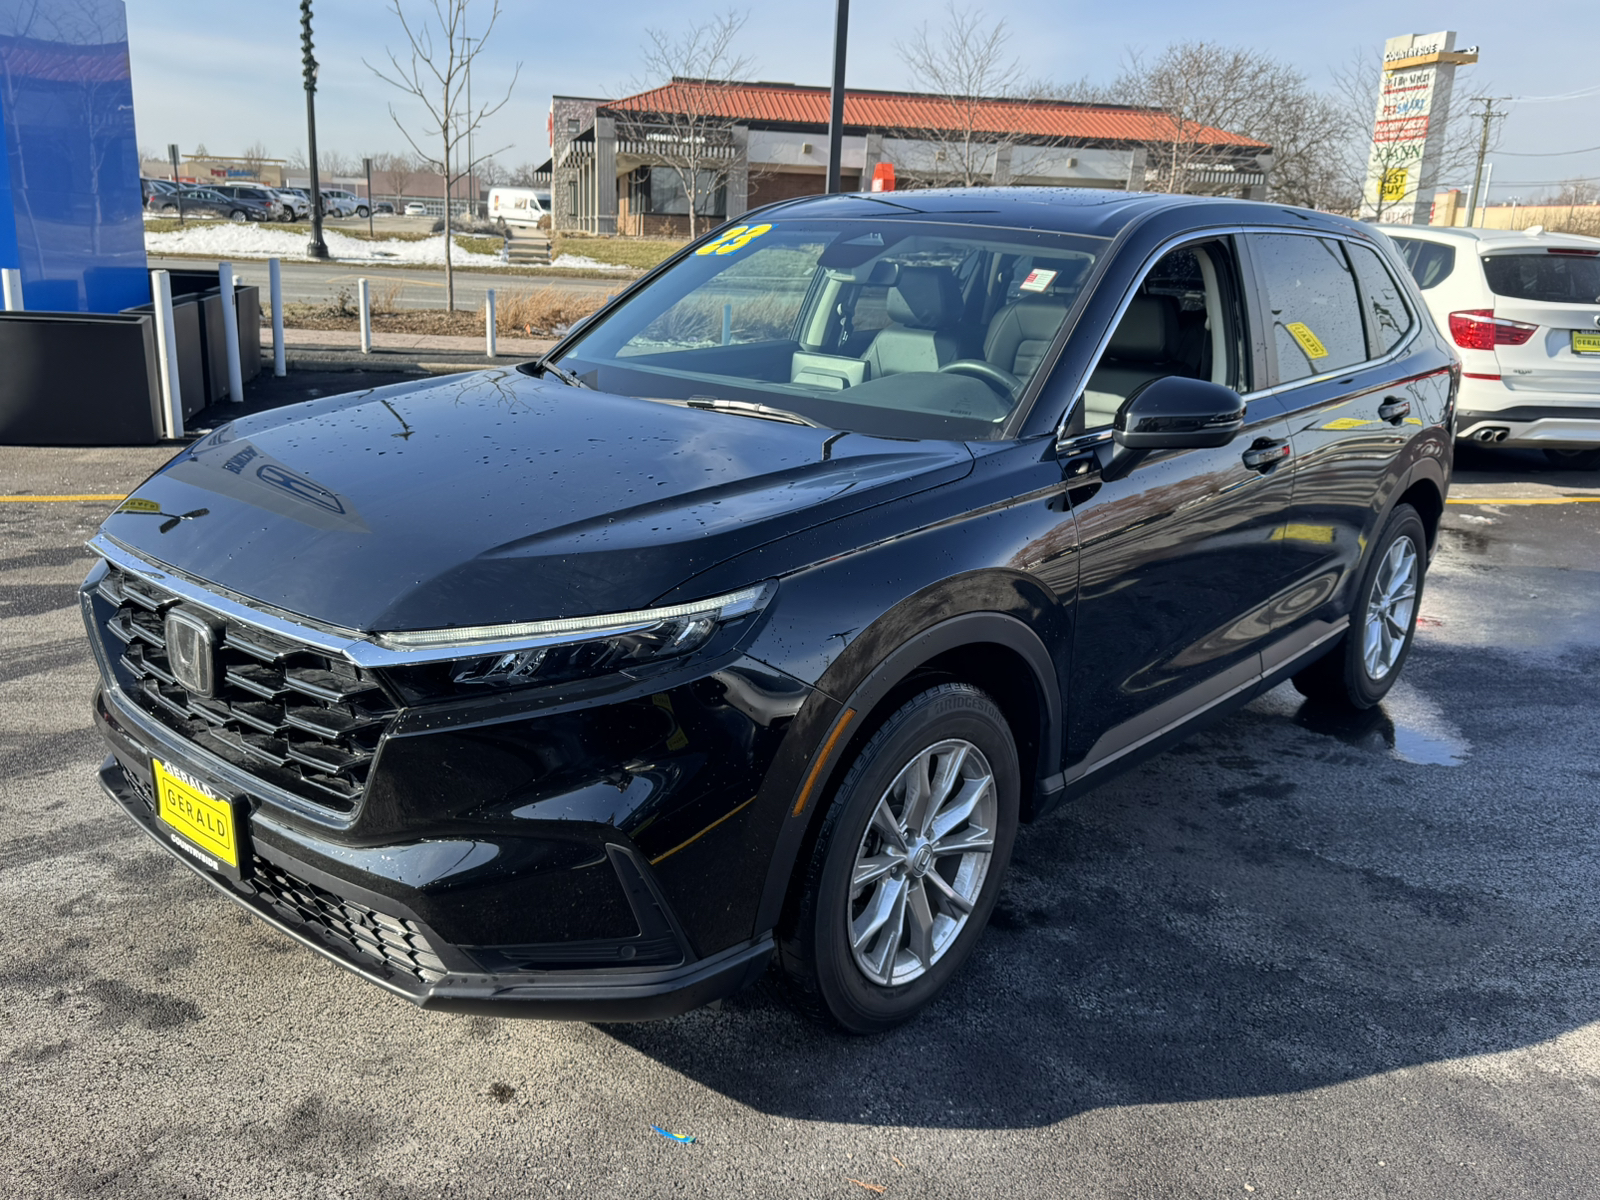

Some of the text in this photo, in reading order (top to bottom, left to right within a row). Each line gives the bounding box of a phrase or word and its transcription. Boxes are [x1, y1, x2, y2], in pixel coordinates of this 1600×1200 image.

[1383, 174, 1406, 184] EST
[695, 223, 773, 256] 23
[934, 696, 1005, 726] BRIDGESTONE
[163, 761, 214, 799] GERALD
[167, 788, 225, 838] GERALD
[170, 833, 219, 871] COUNTRYSIDE
